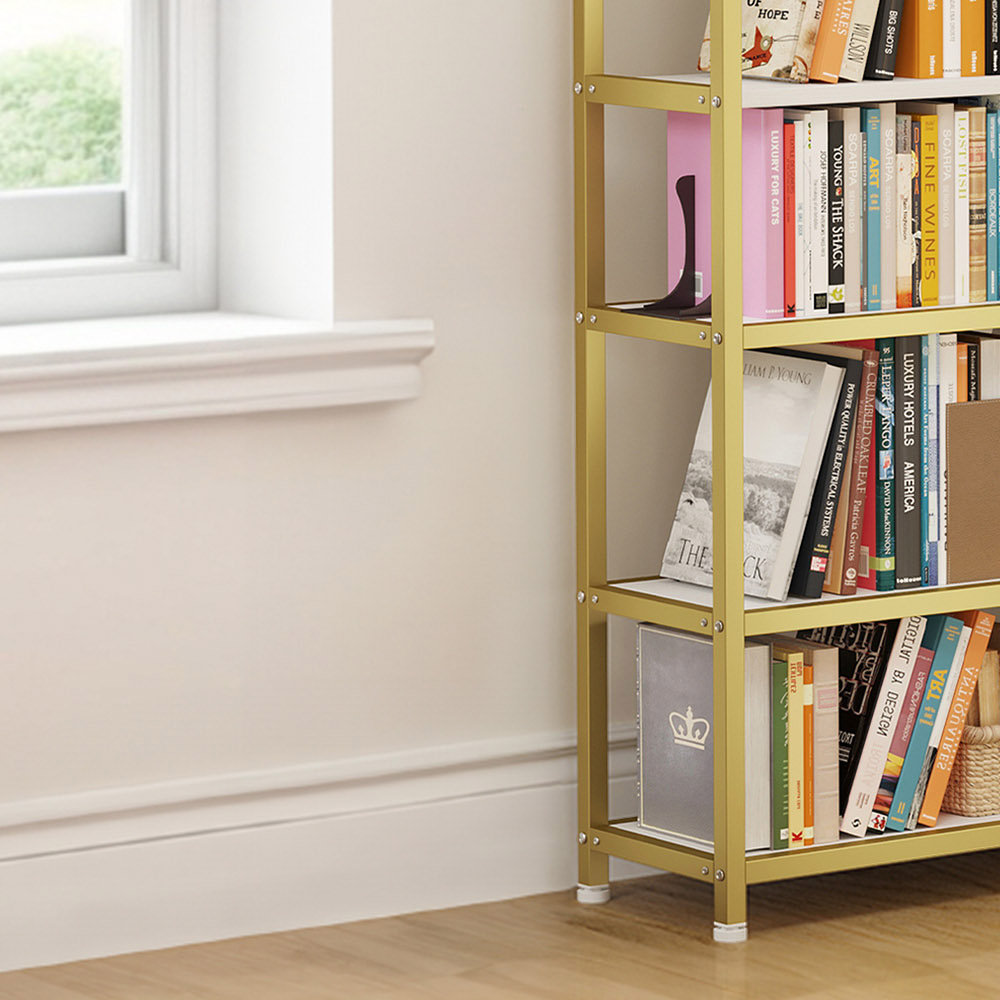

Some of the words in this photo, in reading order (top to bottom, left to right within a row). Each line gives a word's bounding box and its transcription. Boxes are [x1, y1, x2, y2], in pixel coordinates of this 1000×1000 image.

[758, 9, 789, 20] HOPE
[889, 10, 898, 24] BIG
[848, 23, 871, 64] WILLSON
[884, 26, 896, 54] SHOTS
[771, 130, 779, 171] LUXURY
[885, 128, 893, 182] SCARPA
[942, 129, 952, 182] SCARPA
[958, 117, 967, 159] LOST
[833, 144, 843, 186] YOUNG
[848, 133, 857, 185] SCARPA
[869, 156, 879, 188] ART
[925, 142, 935, 192] FINE
[771, 174, 779, 195] FOR
[958, 164, 967, 199] FISH
[771, 198, 779, 225] CATS
[832, 197, 843, 223] THE
[832, 226, 844, 269] SHACK
[924, 204, 936, 280] WINES
[776, 366, 812, 385] YOUNG
[881, 365, 892, 402] LEPER
[904, 353, 914, 399] LUXURY
[844, 383, 855, 409] POWER
[862, 372, 877, 434] CRUMBLED
[838, 410, 850, 445] QUALITY
[882, 407, 893, 448] TANGO
[904, 401, 914, 446] HOTELS
[859, 437, 871, 464] OAK
[827, 452, 843, 500] ELECTRICAL
[856, 465, 869, 494] LEAF
[904, 461, 914, 513] AMERICA
[820, 501, 834, 536] SYSTEMS
[851, 500, 862, 530] Patricia
[678, 538, 709, 569] THE
